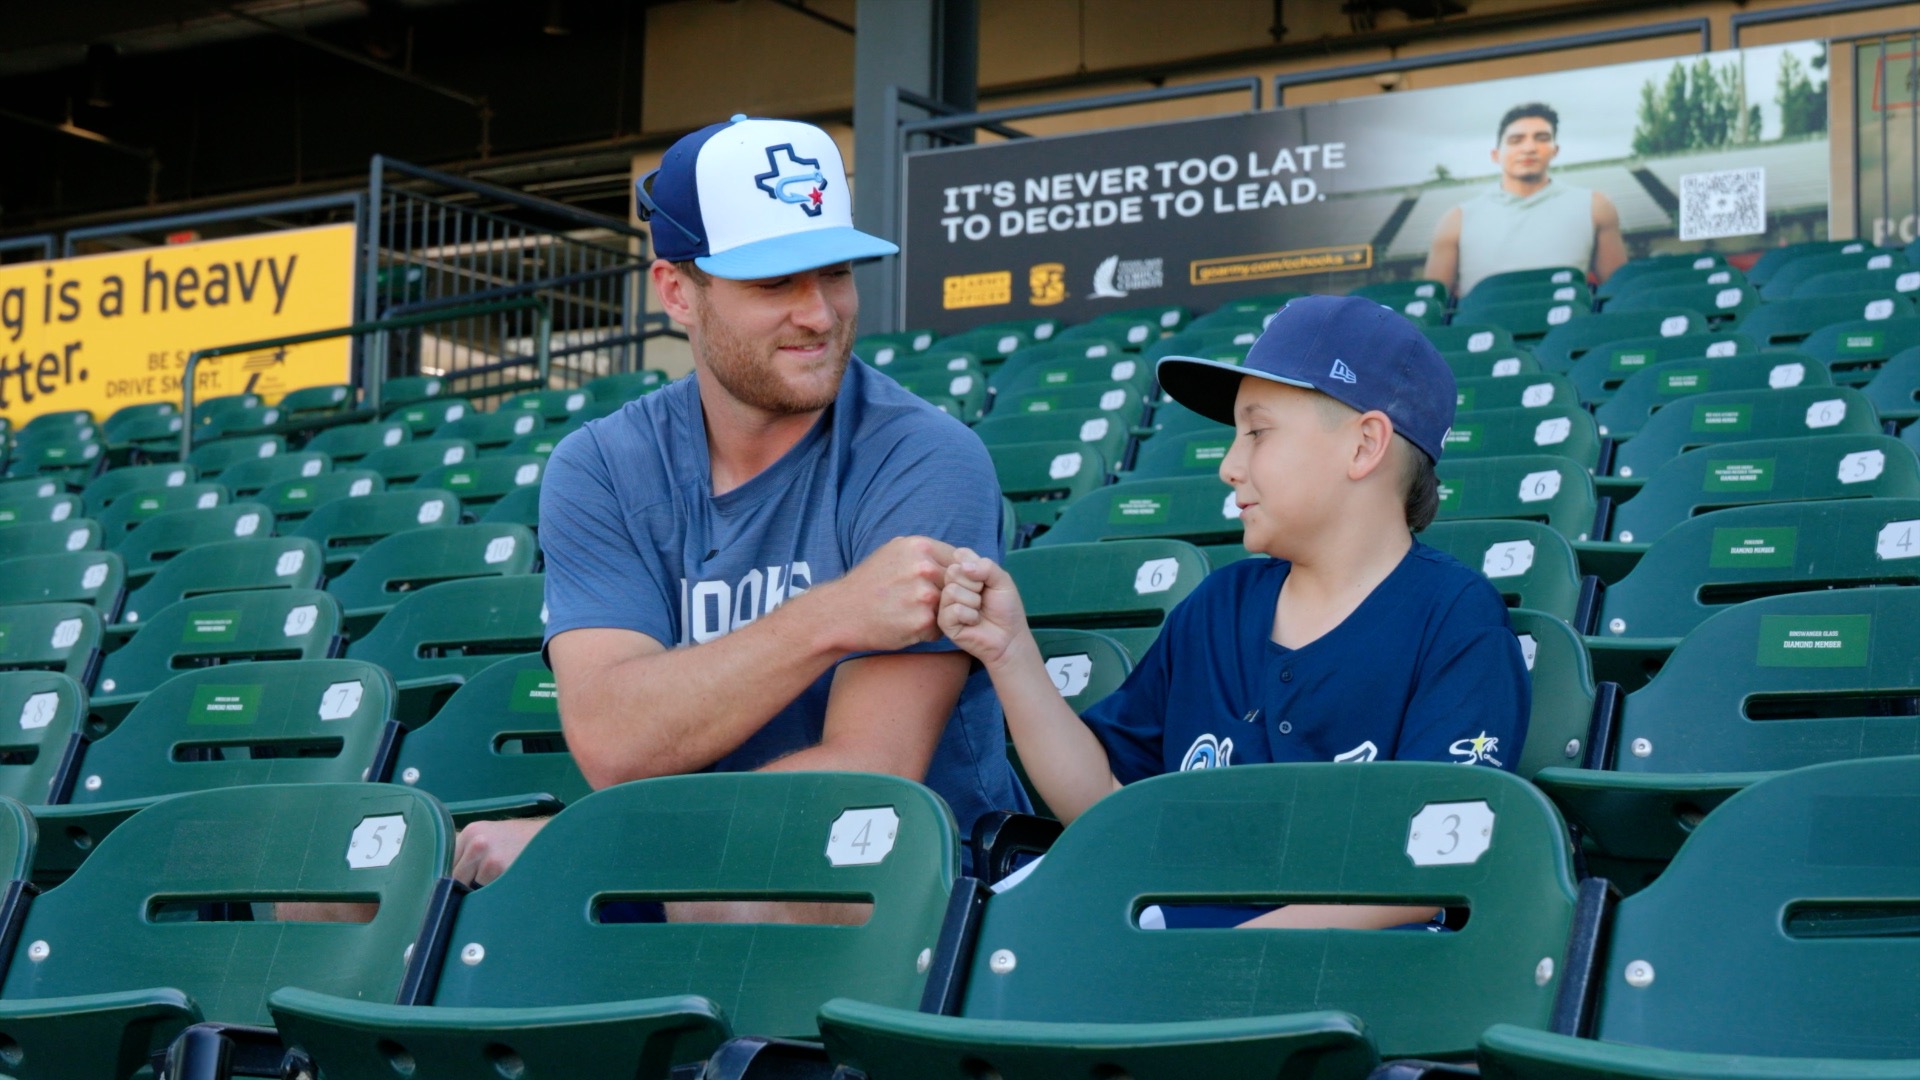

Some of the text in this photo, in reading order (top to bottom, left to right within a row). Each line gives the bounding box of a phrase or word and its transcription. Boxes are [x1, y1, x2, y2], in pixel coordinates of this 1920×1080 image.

[943, 143, 1346, 214] IT'S NEVER TOO LATE
[941, 178, 1327, 243] TO DECIDE TO LEAD.
[43, 268, 81, 325] is
[98, 274, 124, 318] a
[141, 254, 298, 316] heavy
[148, 352, 170, 371] BE
[105, 370, 222, 398] DRIVE SMRT.
[1783, 368, 1793, 383] 7
[1532, 388, 1542, 403] 8
[1819, 405, 1831, 423] 6
[1549, 423, 1559, 440] 7
[1853, 456, 1868, 478] 5
[1534, 476, 1547, 497] 6
[1896, 527, 1912, 552] 4
[1500, 547, 1516, 571] 5
[1150, 568, 1163, 588] 6
[296, 611, 307, 632] 9
[58, 623, 77, 645] 10
[1783, 640, 1842, 648] DIAMOND MEMBER
[1057, 662, 1074, 690] 5
[34, 699, 46, 723] 8
[335, 688, 350, 713] 7
[365, 824, 388, 860] 5
[851, 818, 873, 855] 4
[1435, 814, 1461, 855] 3
